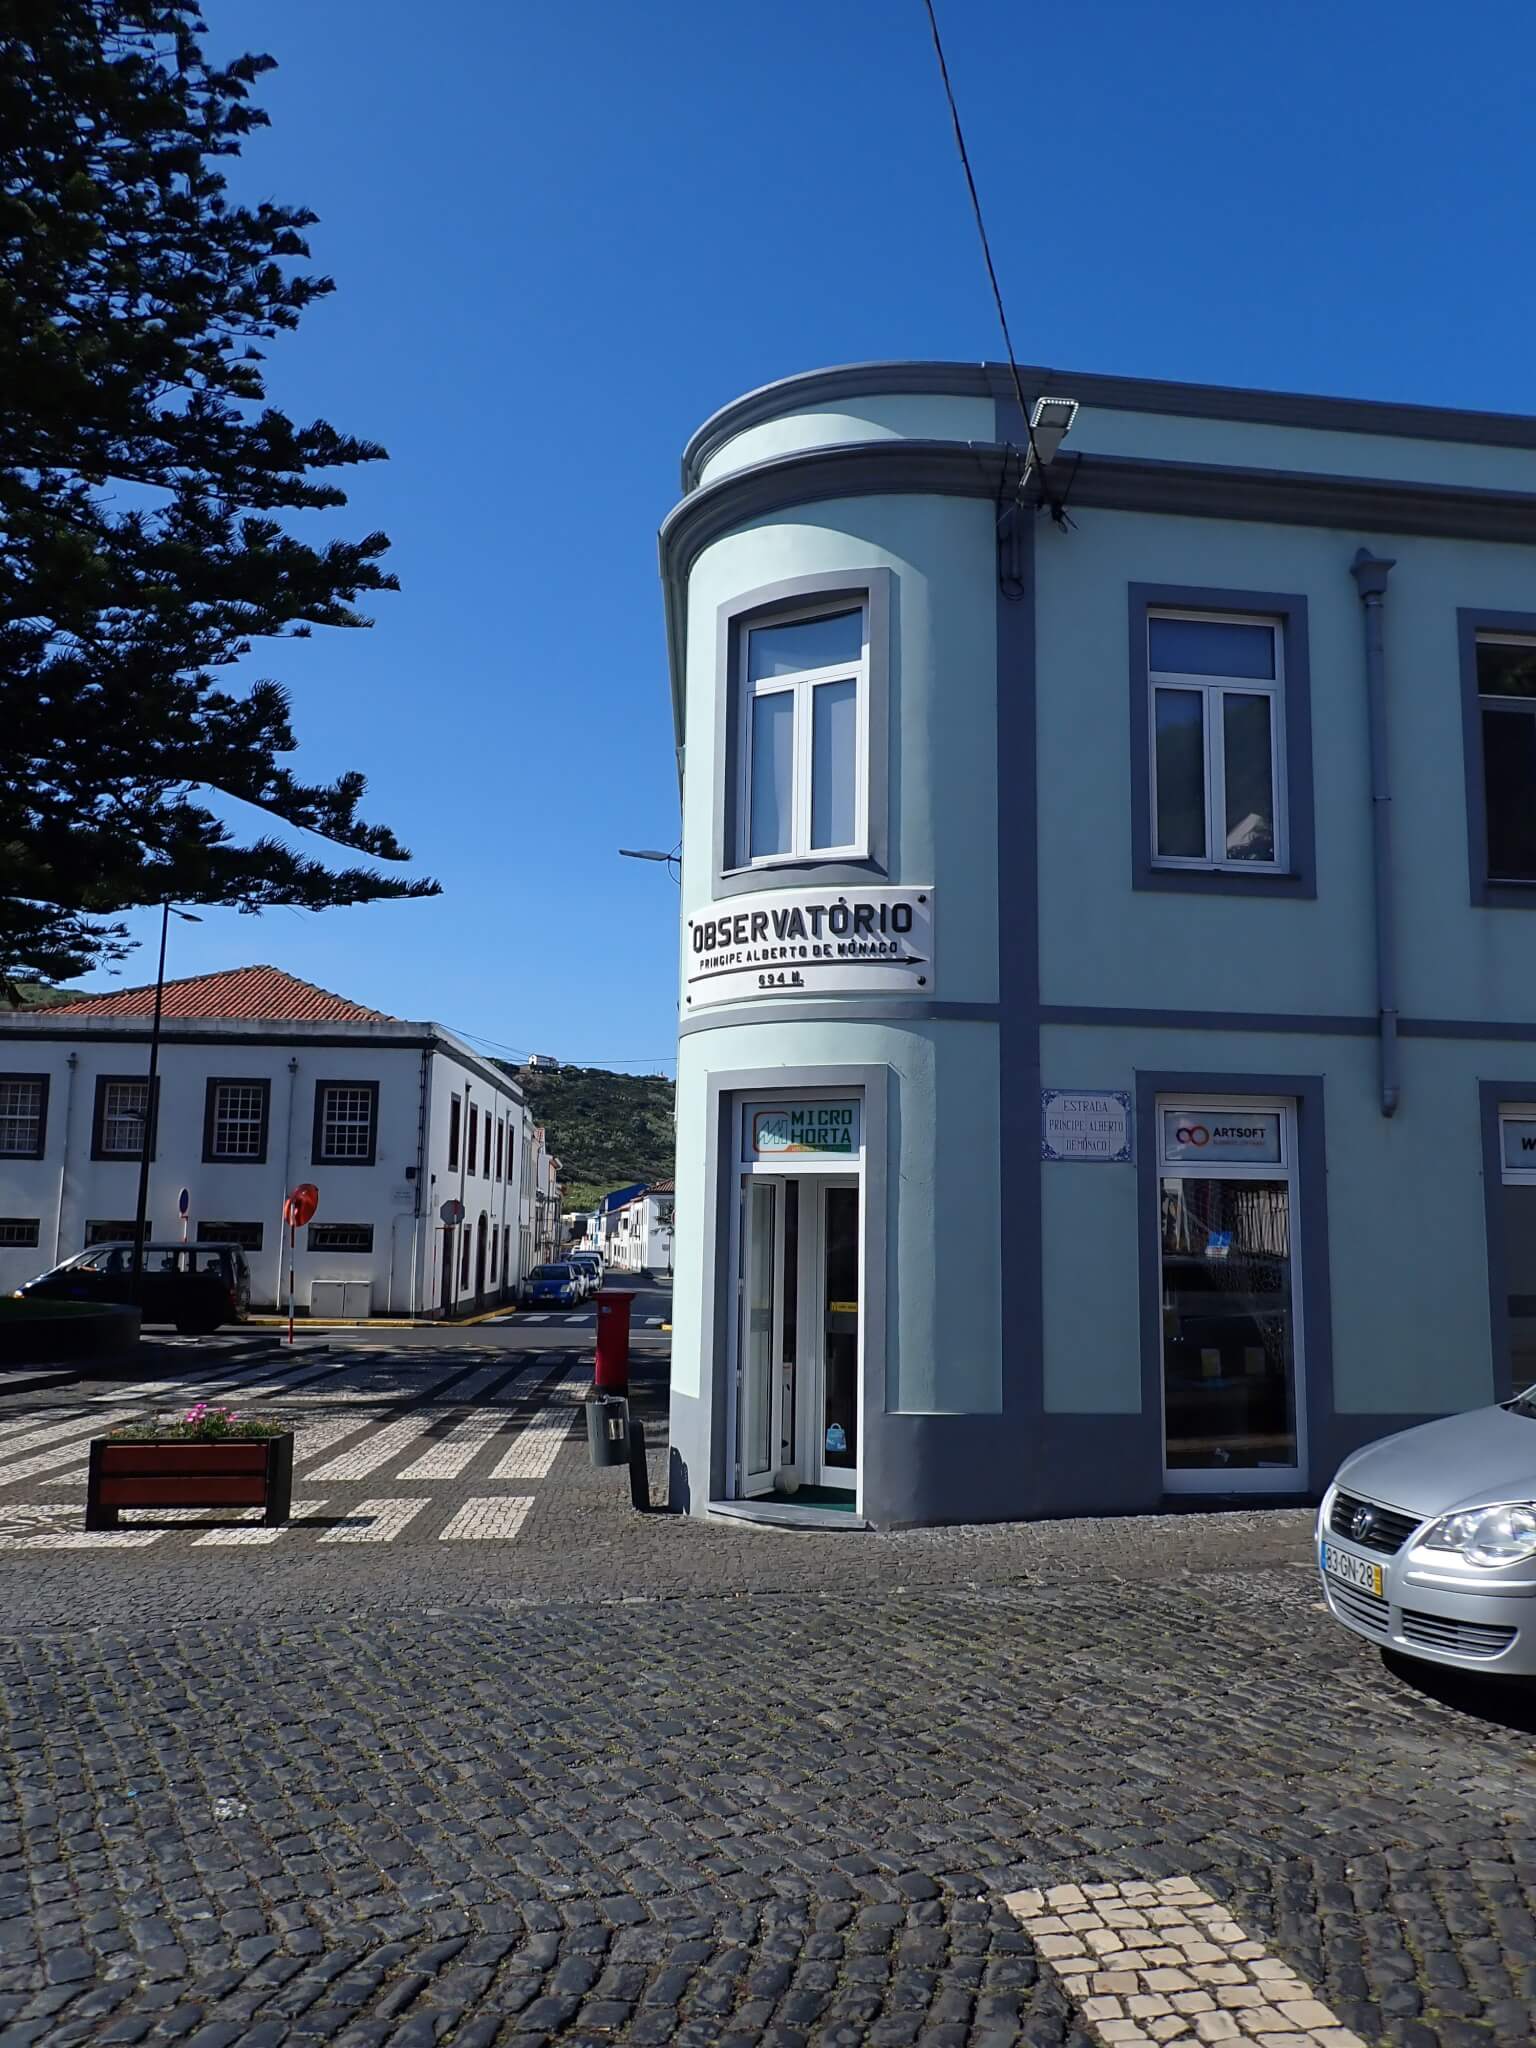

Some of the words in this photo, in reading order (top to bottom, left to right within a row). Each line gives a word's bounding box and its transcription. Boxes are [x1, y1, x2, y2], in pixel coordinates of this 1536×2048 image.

[692, 896, 913, 954] OBSERVATÓRIO
[699, 952, 743, 970] PRINCIPE
[746, 945, 807, 963] ALBERTO
[812, 943, 832, 957] DE
[758, 971, 785, 985] 694
[1063, 1100, 1108, 1112] ESTRADA
[791, 1109, 852, 1126] MICRO
[1089, 1120, 1124, 1133] ALBERTO
[1213, 1127, 1266, 1139] ARTSOFT
[791, 1127, 852, 1143] HORTA
